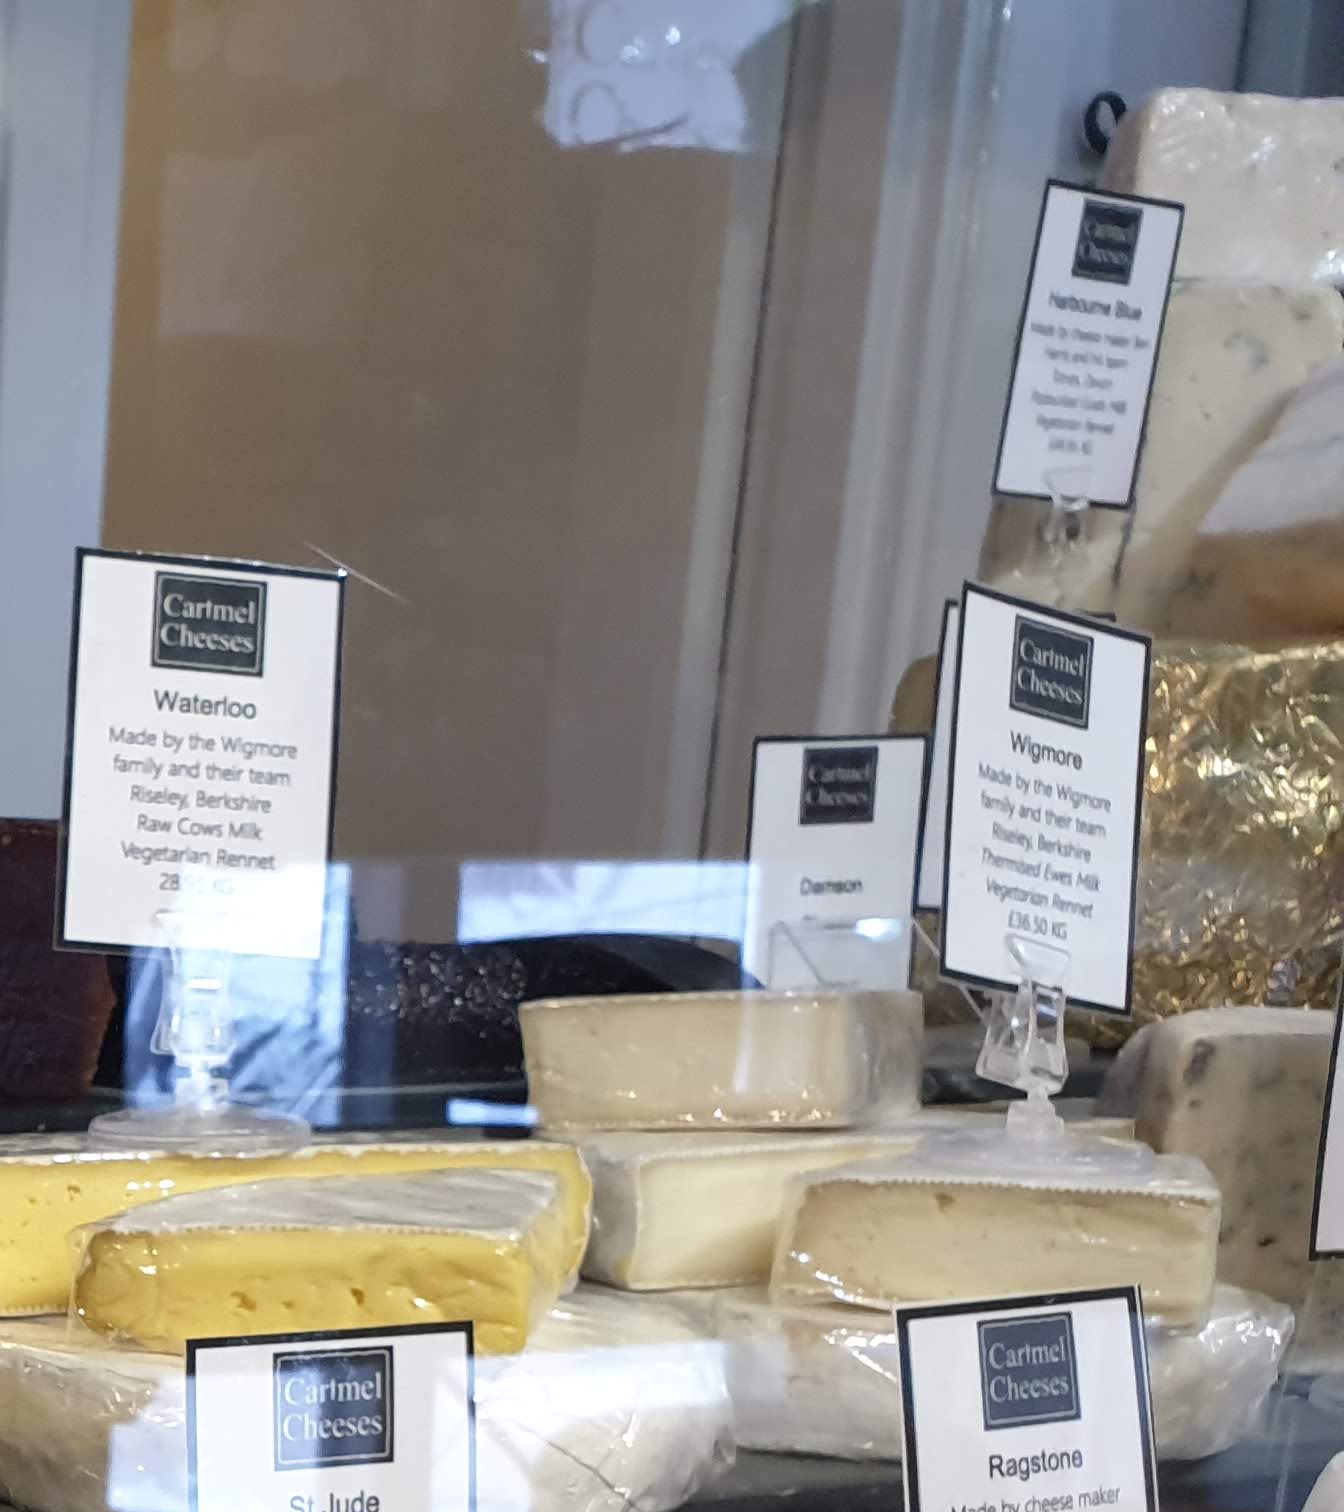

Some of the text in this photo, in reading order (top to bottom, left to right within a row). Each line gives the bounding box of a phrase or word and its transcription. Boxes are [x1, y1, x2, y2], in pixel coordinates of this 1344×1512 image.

[162, 594, 256, 624] Cartmel
[160, 623, 254, 654] Cheeses
[1019, 639, 1084, 678] Cartmel
[1016, 668, 1083, 706] Cheeses
[154, 690, 256, 719] Waterloo
[109, 726, 297, 760] Made by the Wigmore
[1011, 730, 1082, 770] Wigmore
[989, 1336, 1065, 1369] Cartmel
[284, 1371, 382, 1407] Cartmel
[990, 1376, 1069, 1403] Cheeses
[283, 1408, 382, 1441] Cheeses
[988, 1449, 1083, 1483] Ragstone
[1078, 1486, 1121, 1508] maker
